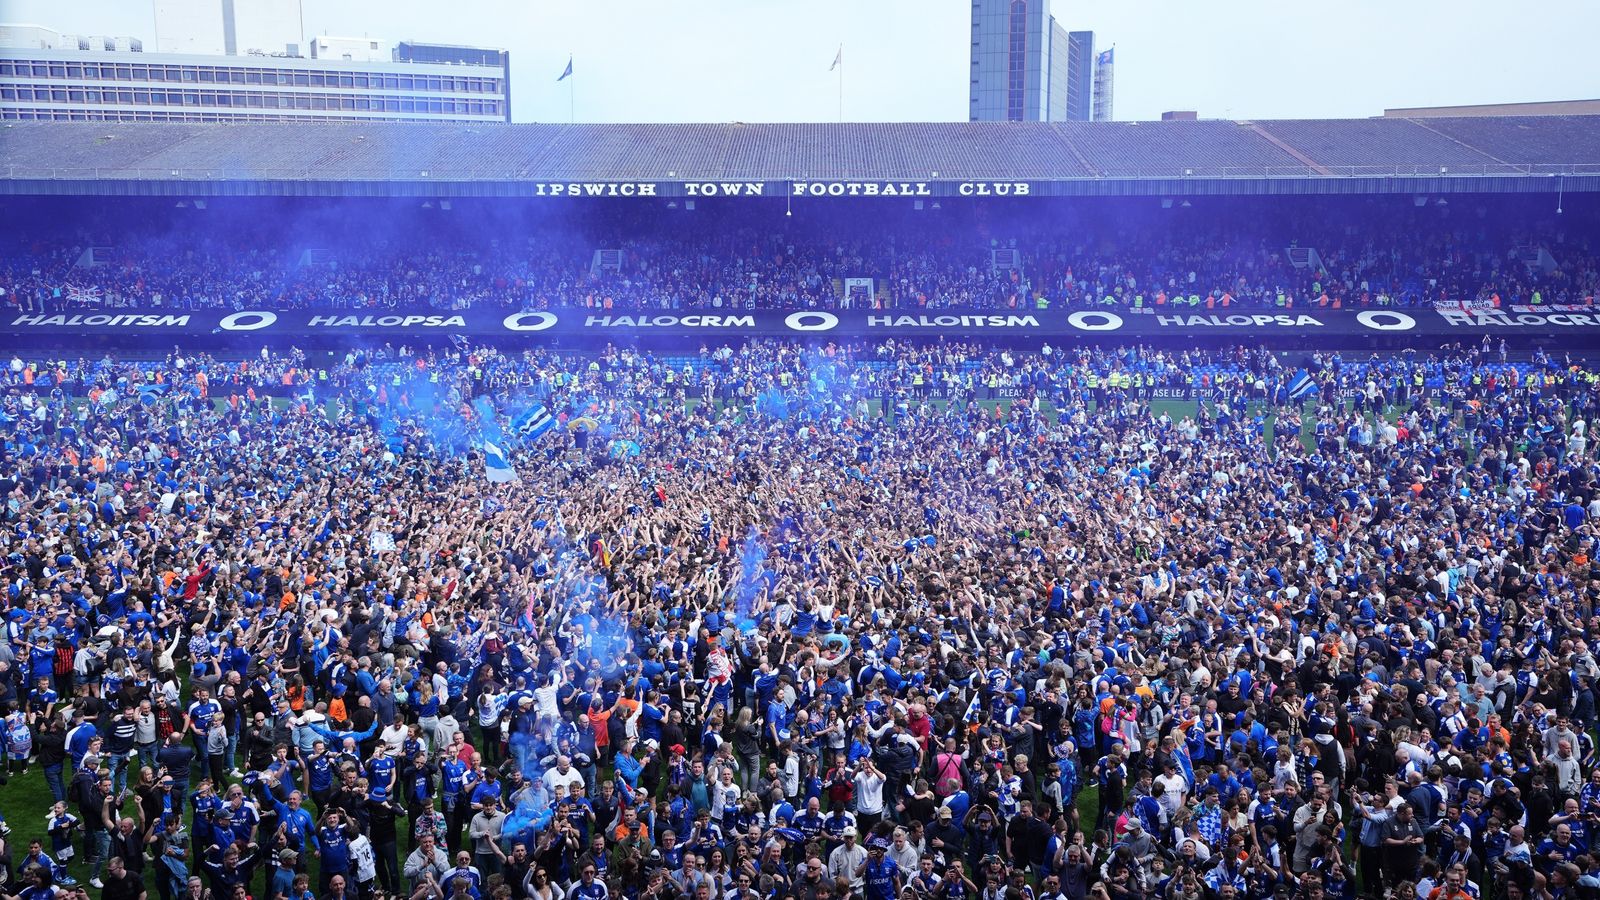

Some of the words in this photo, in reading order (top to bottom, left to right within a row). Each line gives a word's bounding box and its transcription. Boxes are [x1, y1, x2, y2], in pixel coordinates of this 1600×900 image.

[536, 183, 656, 196] IPSWICH
[685, 183, 764, 196] TOWN
[793, 183, 931, 196] FOOTBALL
[959, 183, 1030, 196] CLUB
[11, 313, 190, 326] HALOITSM
[307, 314, 466, 327] HALOPSA
[584, 315, 756, 327] HALOCRM
[867, 315, 1040, 327] HALOITSM
[1157, 314, 1324, 326] HALOPSA
[1441, 313, 1600, 326] HALOCR
[998, 388, 1023, 397] PLEAS
[1171, 388, 1196, 398] LEAE
[1059, 638, 1066, 648] 3
